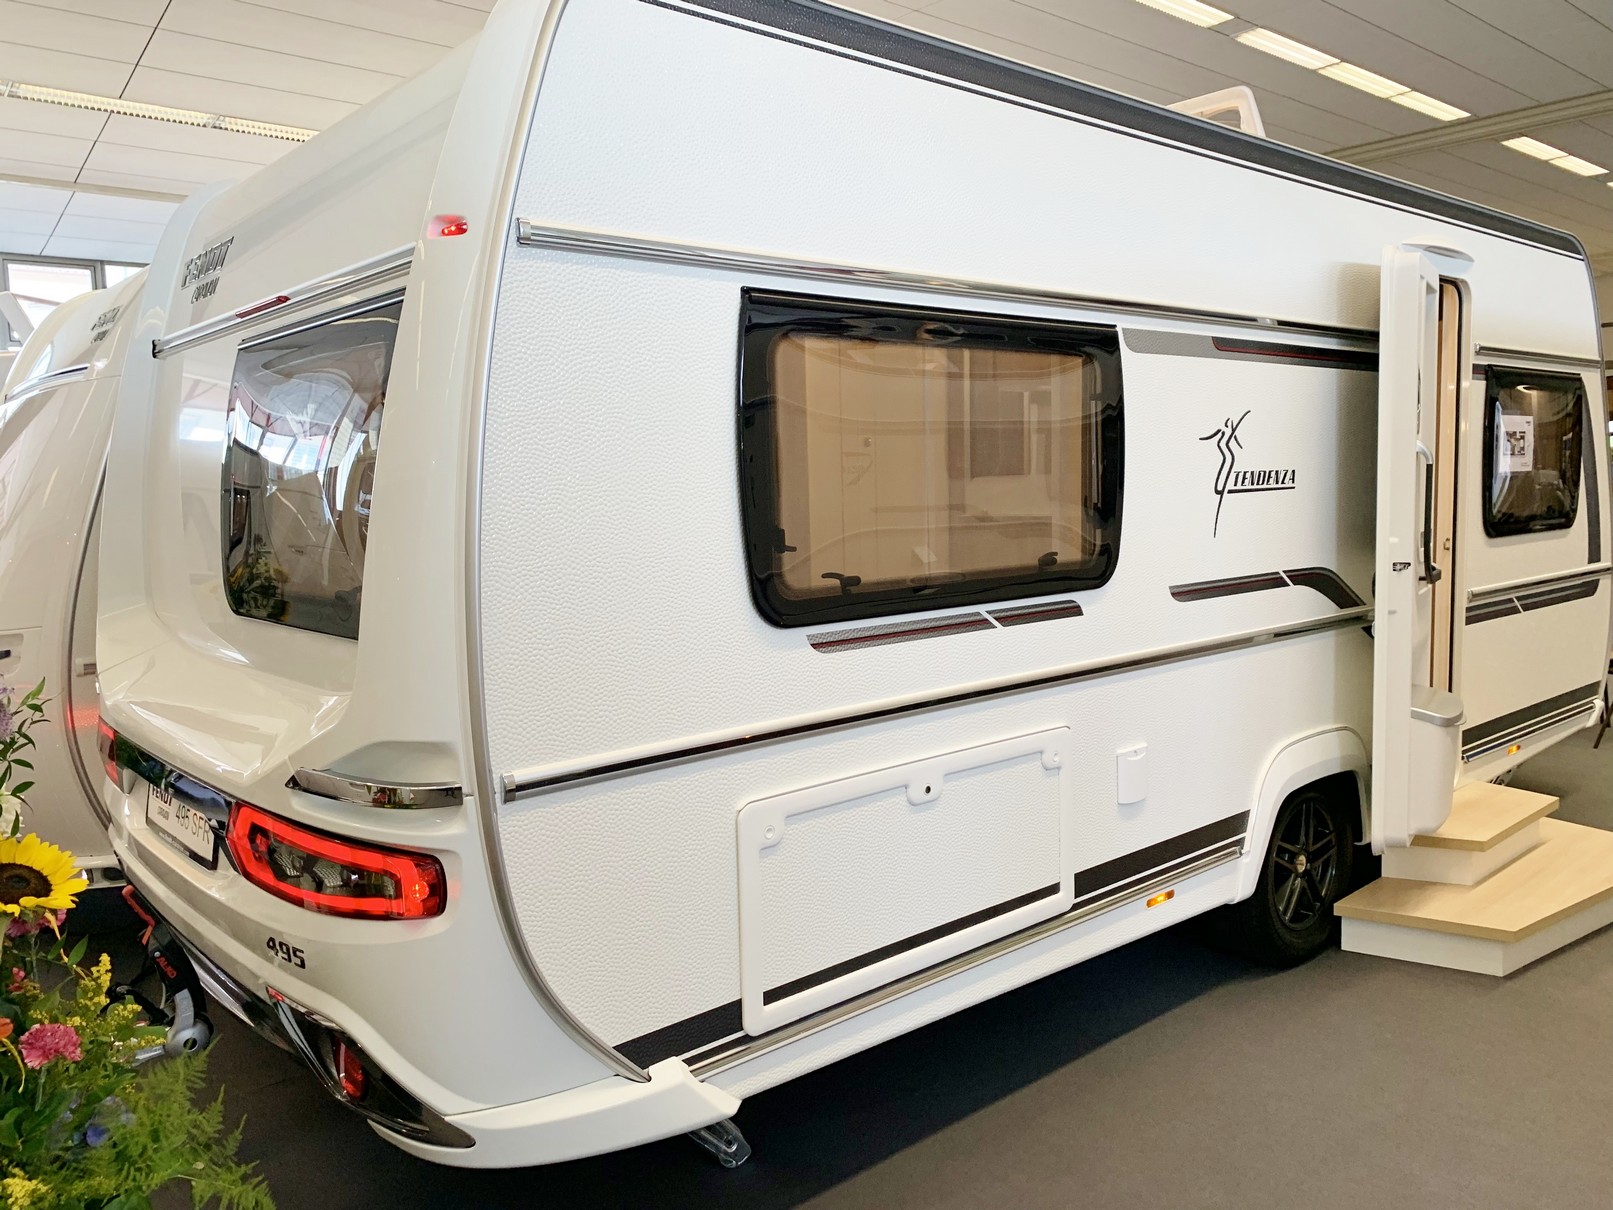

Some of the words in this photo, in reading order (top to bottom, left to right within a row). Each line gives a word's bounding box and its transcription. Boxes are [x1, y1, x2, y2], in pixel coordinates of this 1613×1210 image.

[181, 236, 235, 289] FENDT
[1233, 468, 1296, 488] TENDENZA
[175, 803, 191, 831] 495
[191, 812, 211, 845] SFR
[266, 935, 306, 970] 495
